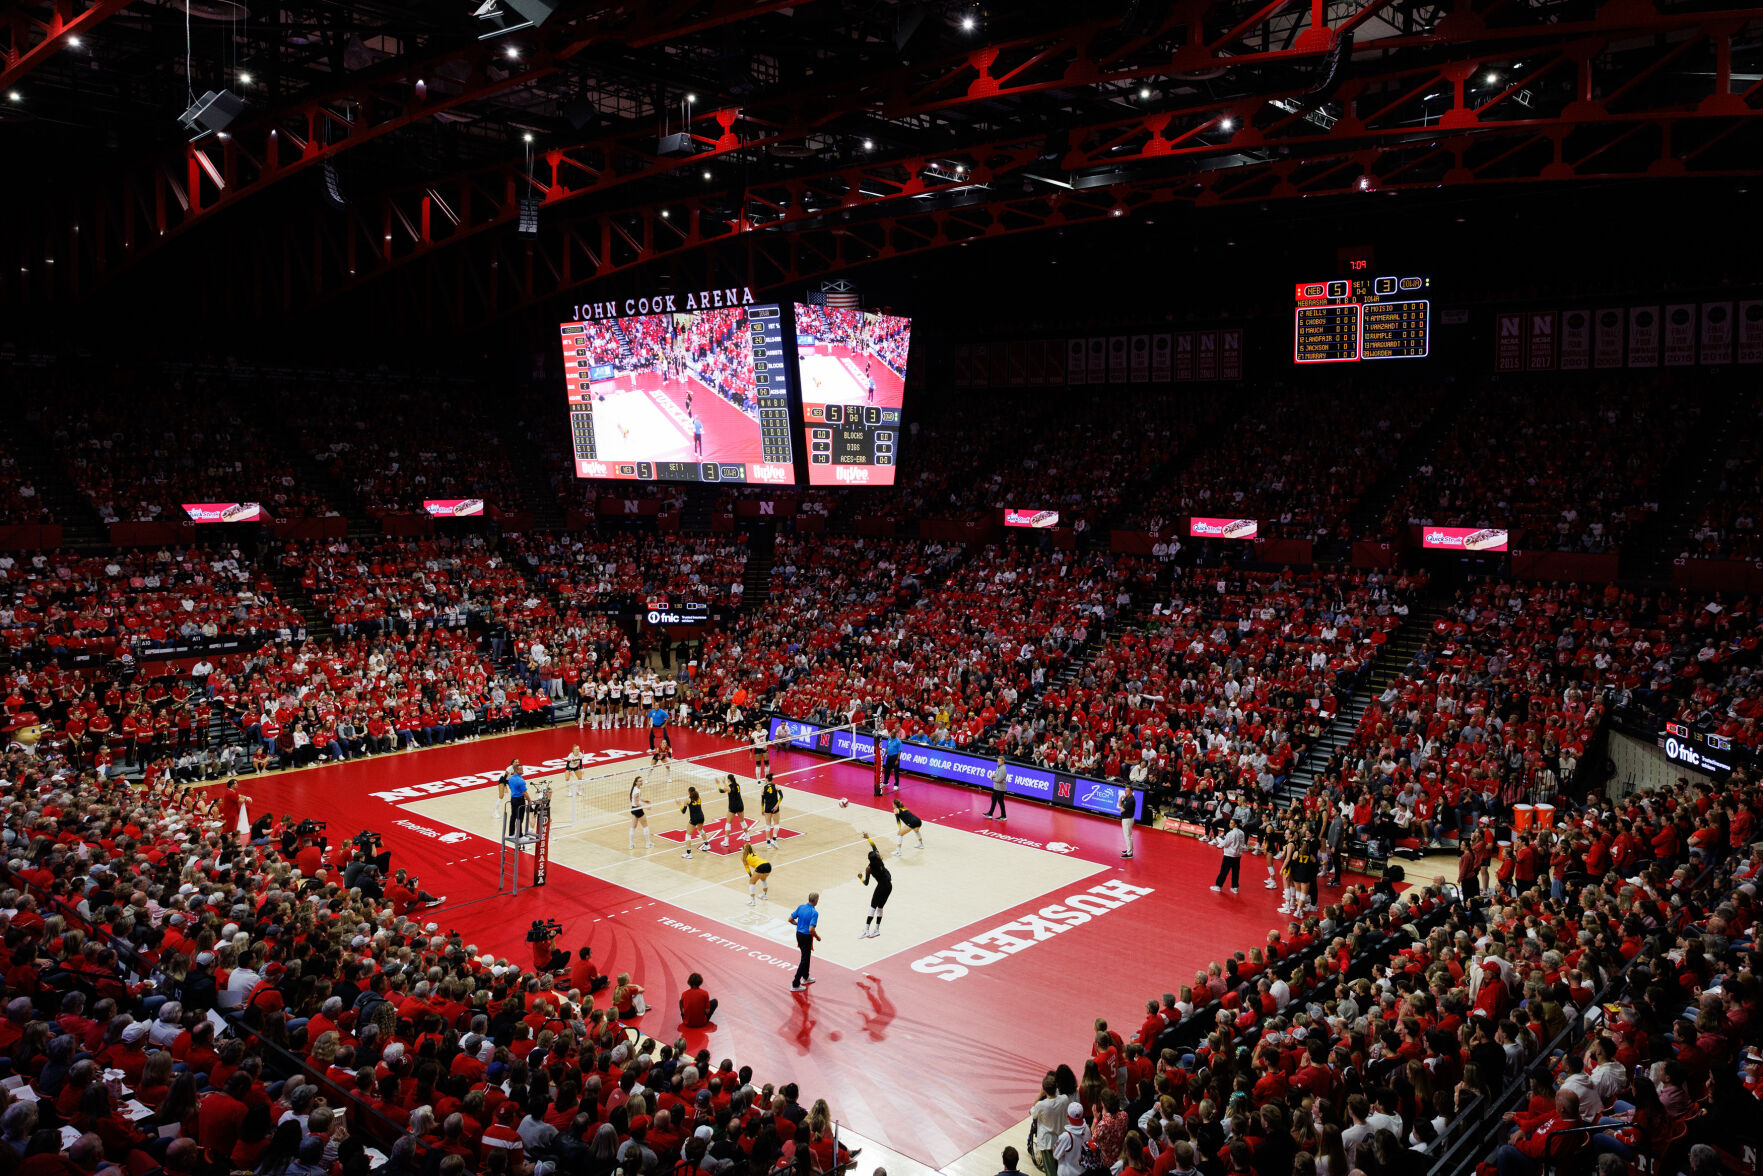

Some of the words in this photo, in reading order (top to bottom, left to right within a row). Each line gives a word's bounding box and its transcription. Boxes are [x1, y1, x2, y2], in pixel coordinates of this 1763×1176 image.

[1350, 260, 1366, 269] 7:09
[1307, 287, 1321, 295] NEB
[1334, 284, 1341, 295] 5
[1383, 280, 1391, 292] 3
[1402, 280, 1420, 288] IOWA
[573, 301, 617, 321] JOHN
[625, 295, 677, 315] COOK
[686, 287, 755, 310] ARENA
[1501, 317, 1520, 336] N
[1533, 315, 1552, 335] N
[831, 407, 837, 420] 5
[870, 409, 876, 421] 3
[641, 464, 648, 477] 5
[708, 465, 715, 479] 3
[624, 501, 639, 513] N
[760, 502, 774, 514] N
[661, 613, 680, 622] fnic
[820, 733, 830, 746] N
[838, 739, 850, 749] THE
[851, 742, 875, 754] OFFICIA
[1679, 744, 1700, 765] fnic
[912, 754, 928, 765] AND
[928, 757, 952, 770] SOLAR
[952, 763, 986, 777] EXPERTS
[1014, 775, 1050, 791] HUSKERS
[767, 786, 773, 794] 4
[1058, 782, 1071, 797] N
[974, 829, 1042, 847] Ameritas
[1299, 854, 1309, 864] 17
[910, 879, 1156, 981] HUSKERS
[657, 916, 701, 934] TERRY
[697, 932, 749, 952] PETTIT
[748, 951, 799, 971] COURT
